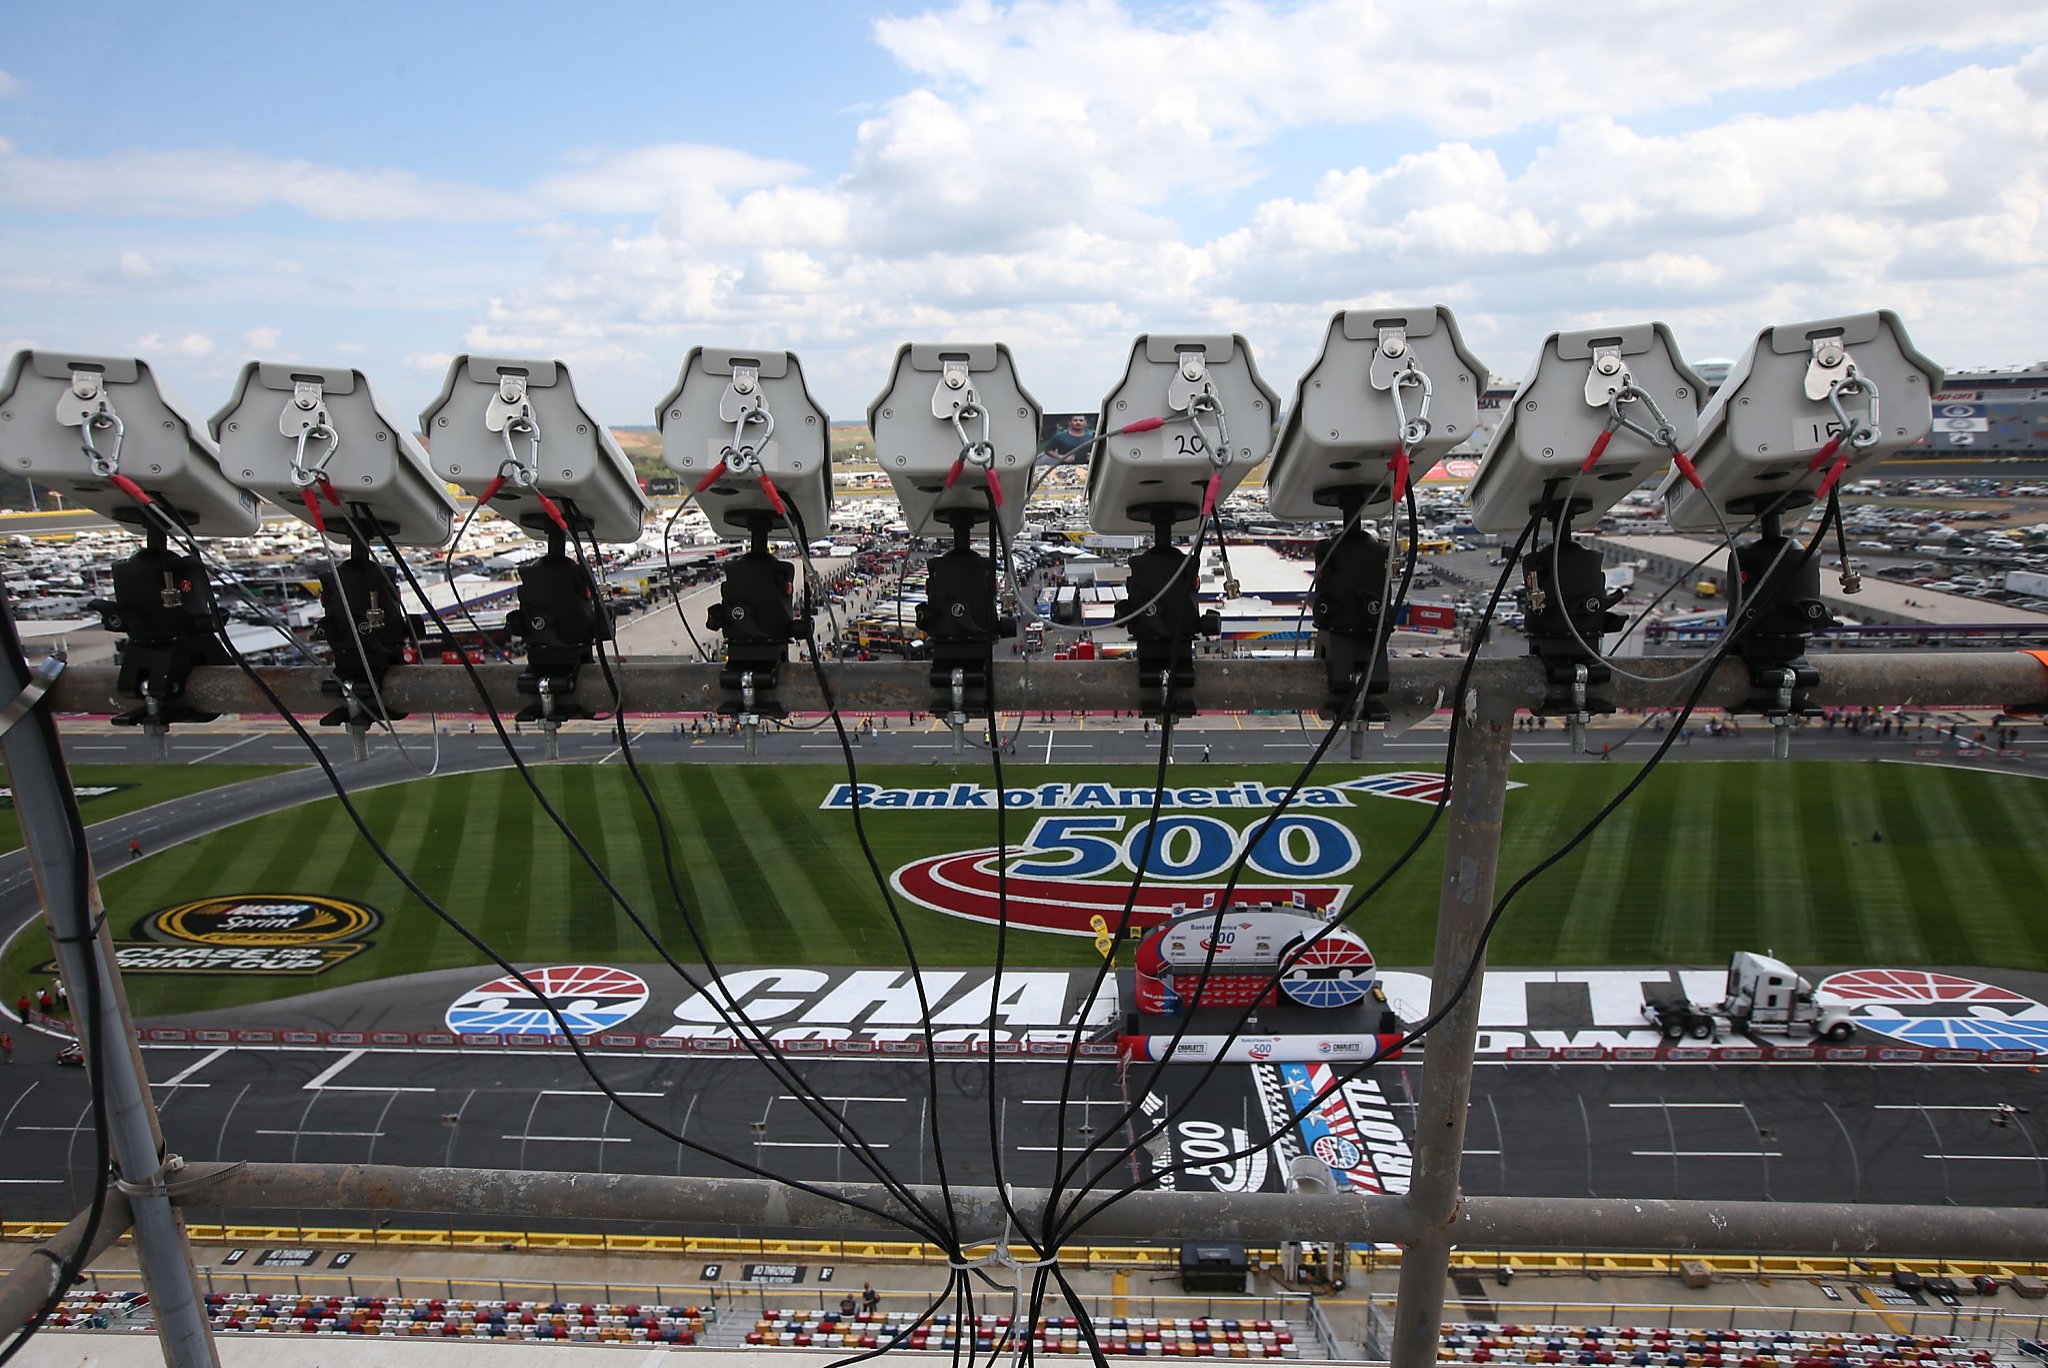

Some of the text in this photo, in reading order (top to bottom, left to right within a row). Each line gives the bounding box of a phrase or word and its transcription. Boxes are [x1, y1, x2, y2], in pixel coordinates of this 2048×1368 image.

[1174, 434, 1205, 456] 20
[819, 782, 1358, 810] Bank of America
[1006, 814, 1362, 880] 500
[217, 916, 299, 931] Sprint
[116, 947, 276, 959] CHASE
[116, 958, 324, 970] PRINT CUP
[1254, 1043, 1272, 1054] 500
[1338, 1075, 1413, 1196] ARLOTTE
[1178, 1120, 1234, 1179] 500
[705, 1266, 718, 1277] G
[752, 1265, 798, 1277] NO THROWING
[821, 1268, 833, 1279] F
